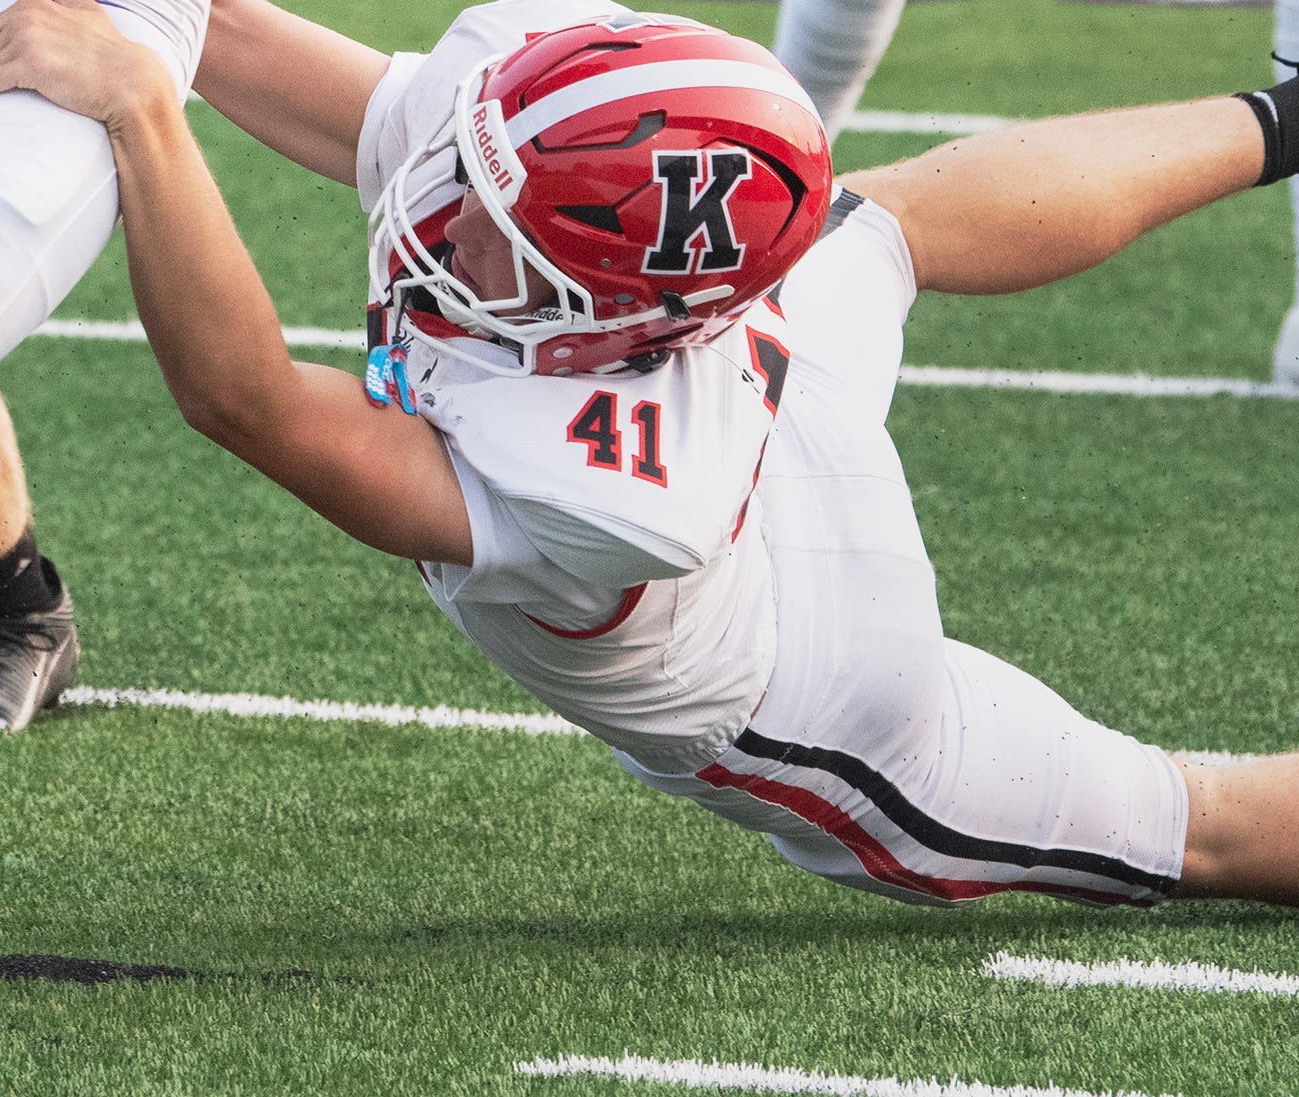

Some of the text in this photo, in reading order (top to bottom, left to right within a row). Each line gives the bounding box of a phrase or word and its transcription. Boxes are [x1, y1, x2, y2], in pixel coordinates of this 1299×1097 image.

[473, 106, 514, 191] Riddell
[641, 149, 752, 276] K
[566, 389, 668, 489] 41
